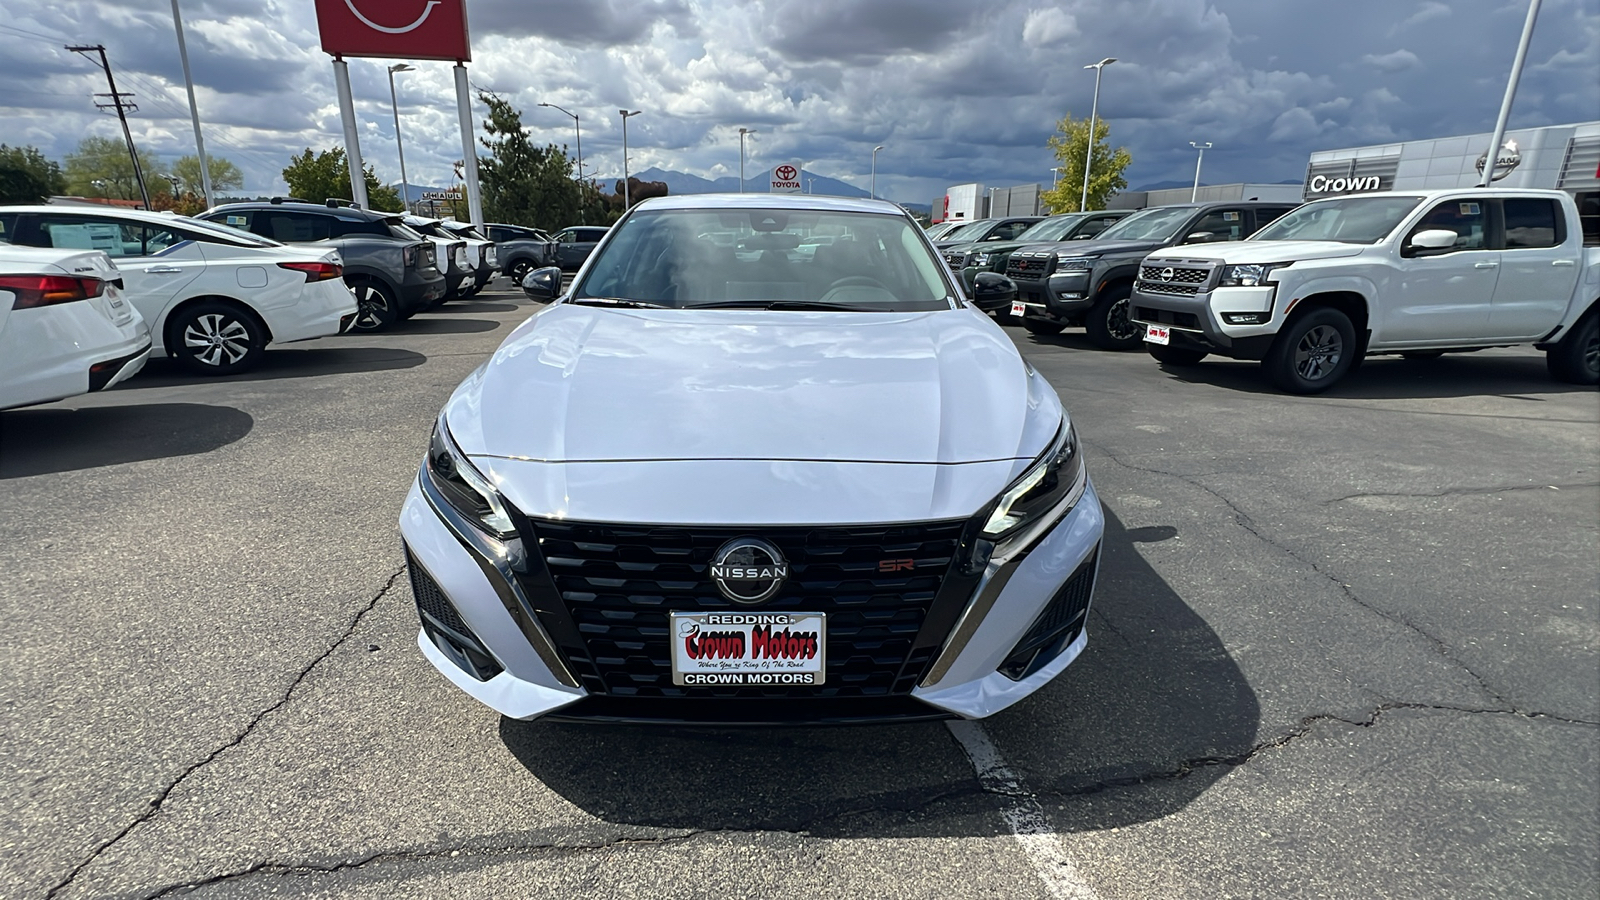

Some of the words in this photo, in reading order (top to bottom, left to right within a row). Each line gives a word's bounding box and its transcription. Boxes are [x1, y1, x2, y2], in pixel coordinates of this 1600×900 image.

[1311, 175, 1380, 192] Crown
[878, 558, 915, 572] SR
[711, 566, 787, 578] NISSAN
[708, 615, 788, 624] REDDING
[685, 624, 746, 660] Crown
[751, 624, 818, 660] Motors
[719, 660, 741, 670] You're
[743, 661, 759, 669] King
[761, 661, 770, 669] Of
[684, 674, 743, 684] CROWN
[747, 674, 814, 684] MOTORS
